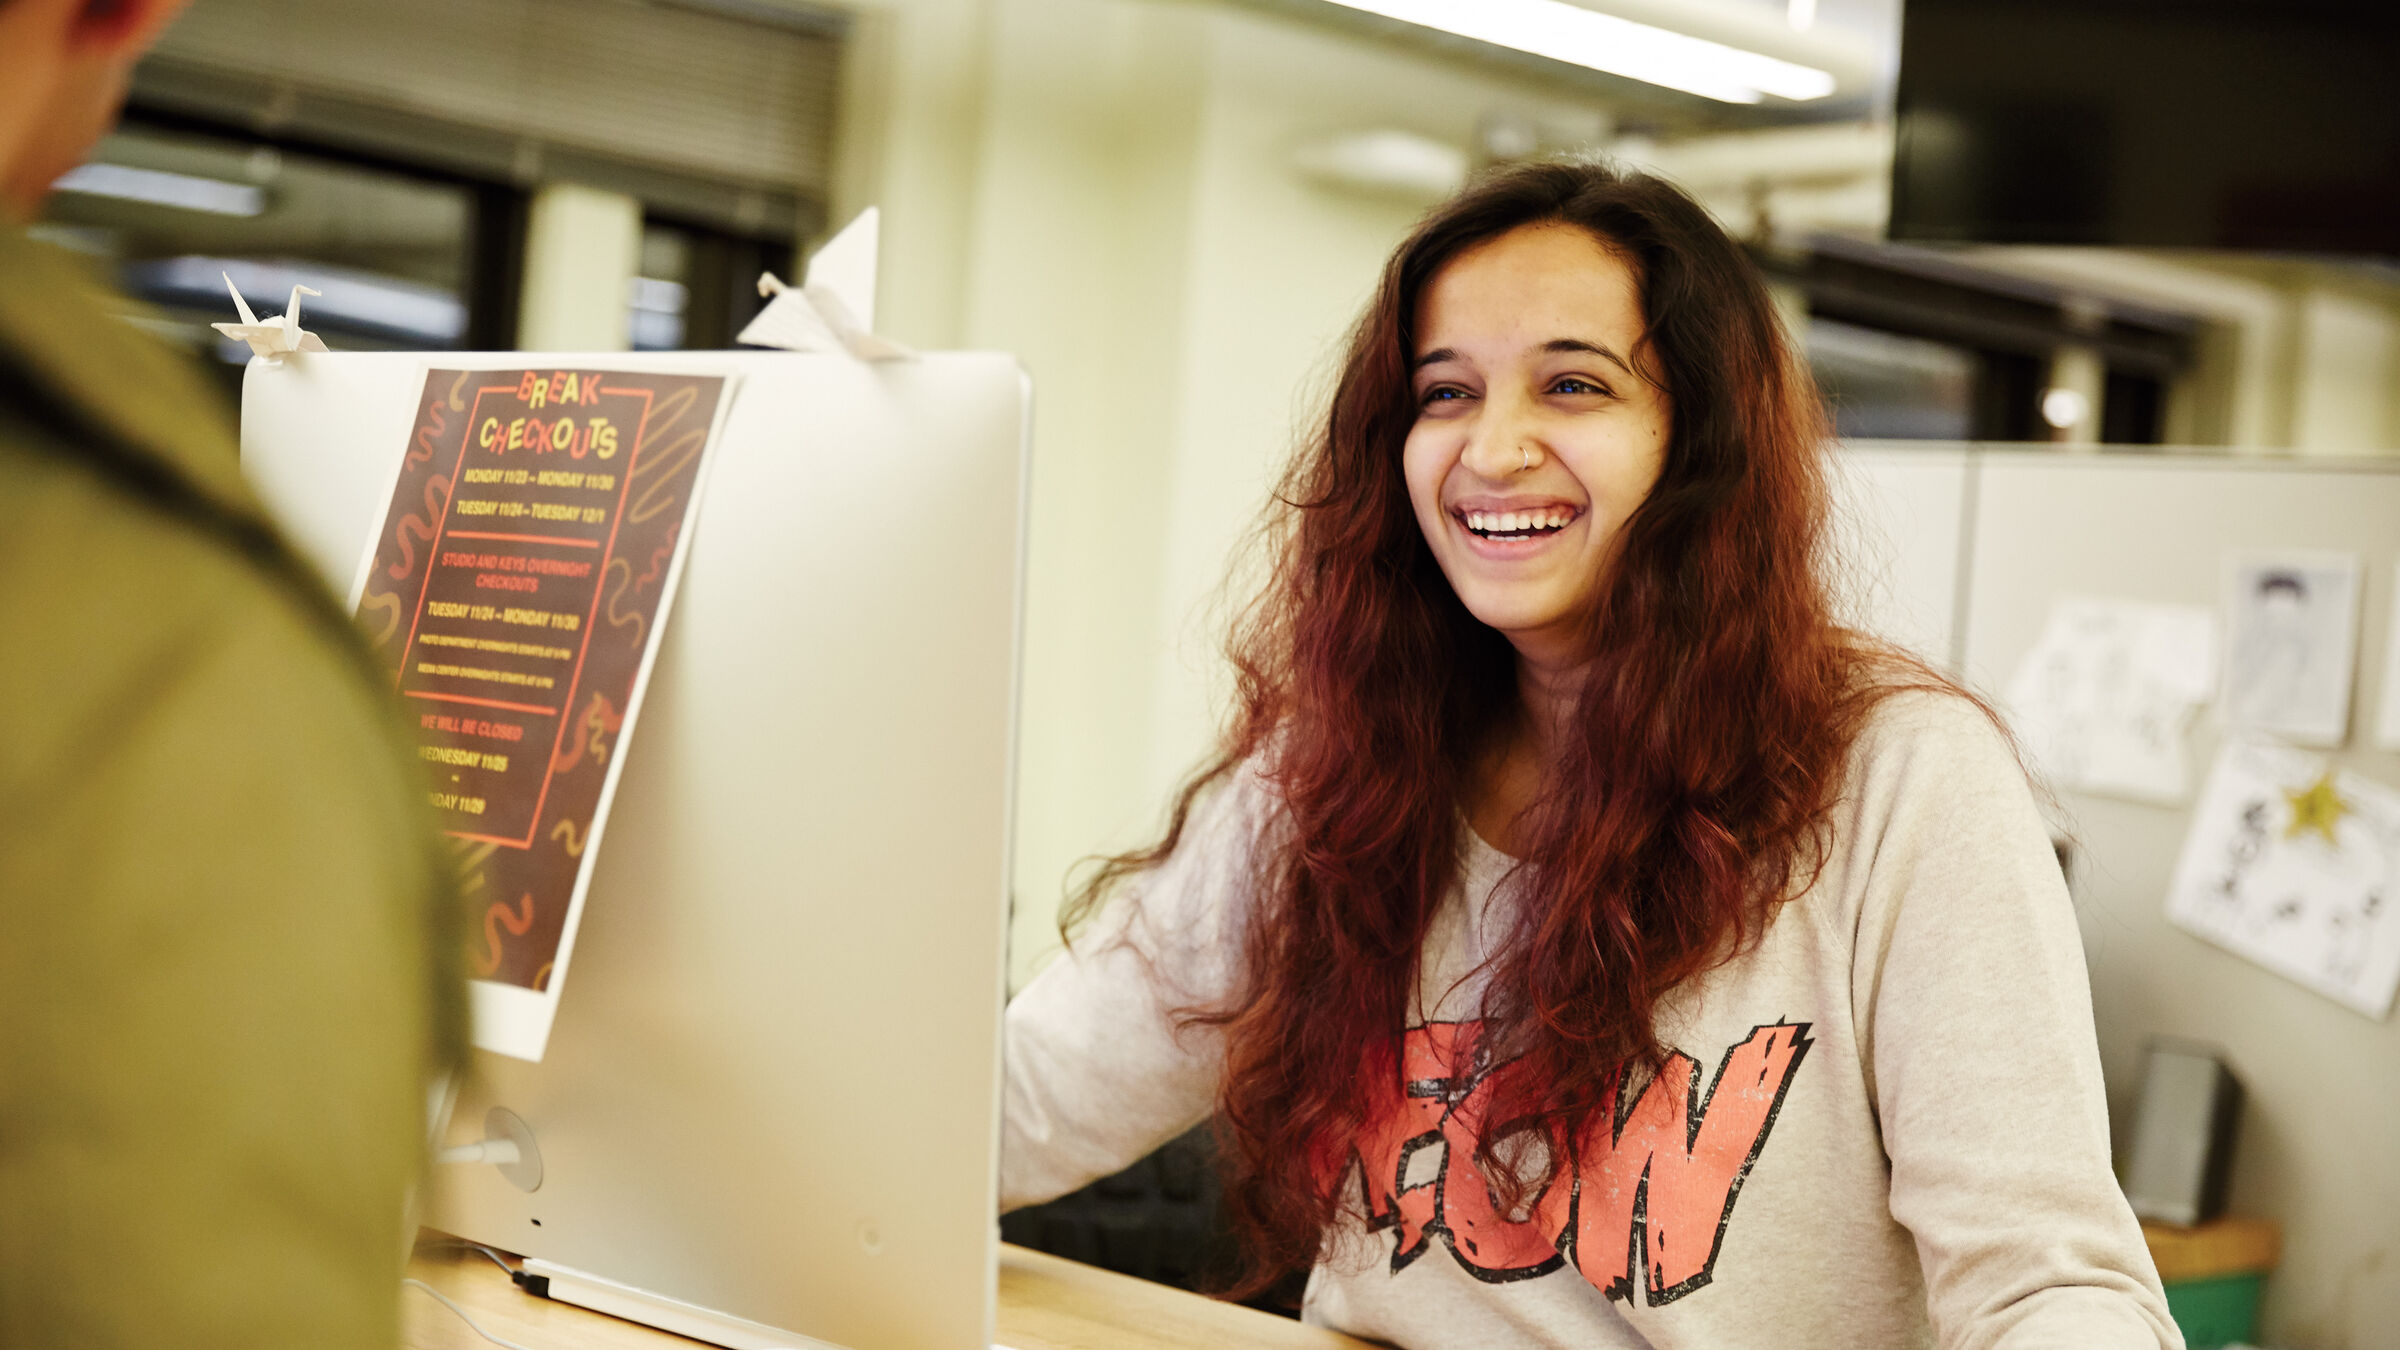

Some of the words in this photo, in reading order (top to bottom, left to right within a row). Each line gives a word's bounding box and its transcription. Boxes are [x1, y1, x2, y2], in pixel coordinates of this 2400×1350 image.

[517, 371, 602, 409] BREAK
[480, 417, 618, 459] CHECKOUTS
[464, 469, 504, 483] MONDAY
[537, 470, 584, 488] MONDAY
[457, 500, 499, 515] TUESDAY
[499, 502, 523, 517] 11/24
[531, 503, 581, 521] TUESDAY
[442, 552, 476, 568] STUDIO
[476, 554, 498, 569] AND
[498, 556, 527, 572] KEYS
[527, 558, 592, 578] OVERNIGHT
[475, 573, 539, 593] CHECKOUTS
[428, 601, 470, 619] TUESDAY
[470, 605, 496, 621] 11/24
[503, 608, 551, 627] MONDAY
[421, 714, 437, 730] WE
[437, 716, 460, 733] WILL
[460, 718, 478, 735] BE
[478, 721, 524, 741] CLOSED
